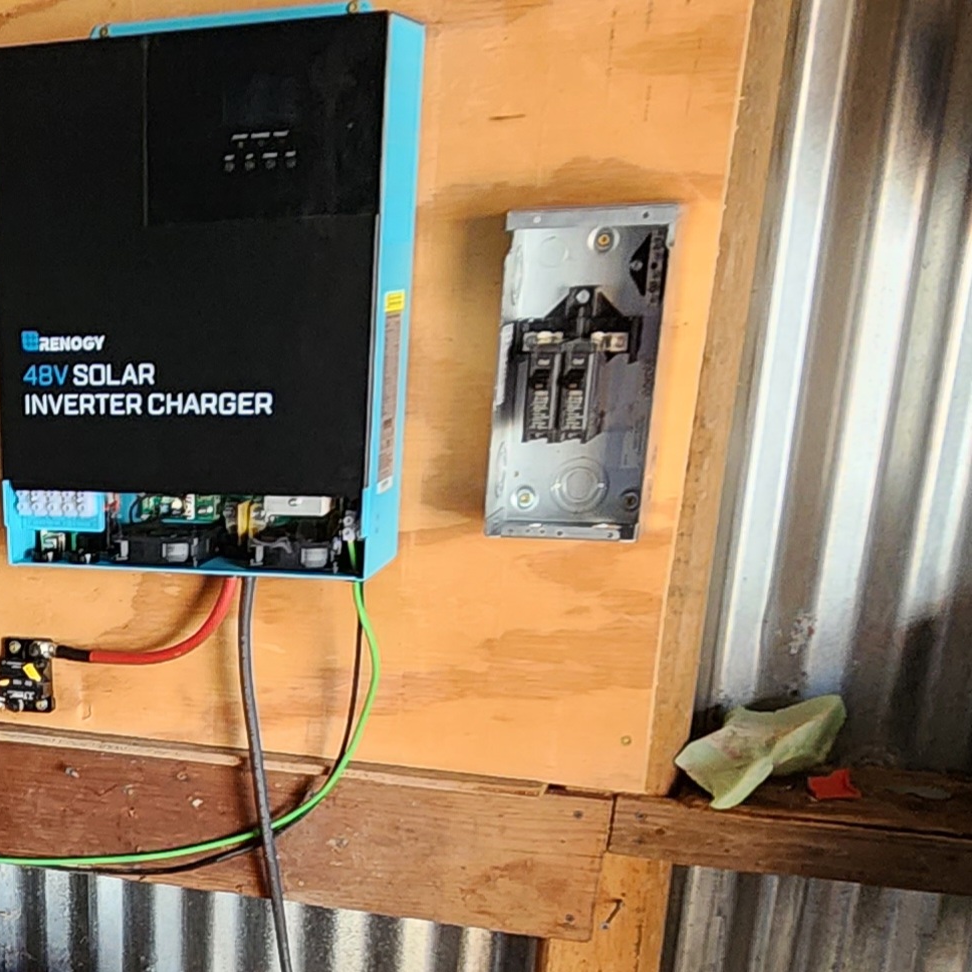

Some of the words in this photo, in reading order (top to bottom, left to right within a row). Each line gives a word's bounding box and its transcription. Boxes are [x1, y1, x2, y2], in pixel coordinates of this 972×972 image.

[39, 335, 105, 352] RENOGY
[22, 364, 68, 386] 48V
[72, 363, 155, 386] SOLAR
[24, 393, 142, 416] INVERTER
[147, 392, 273, 416] CHARGER
